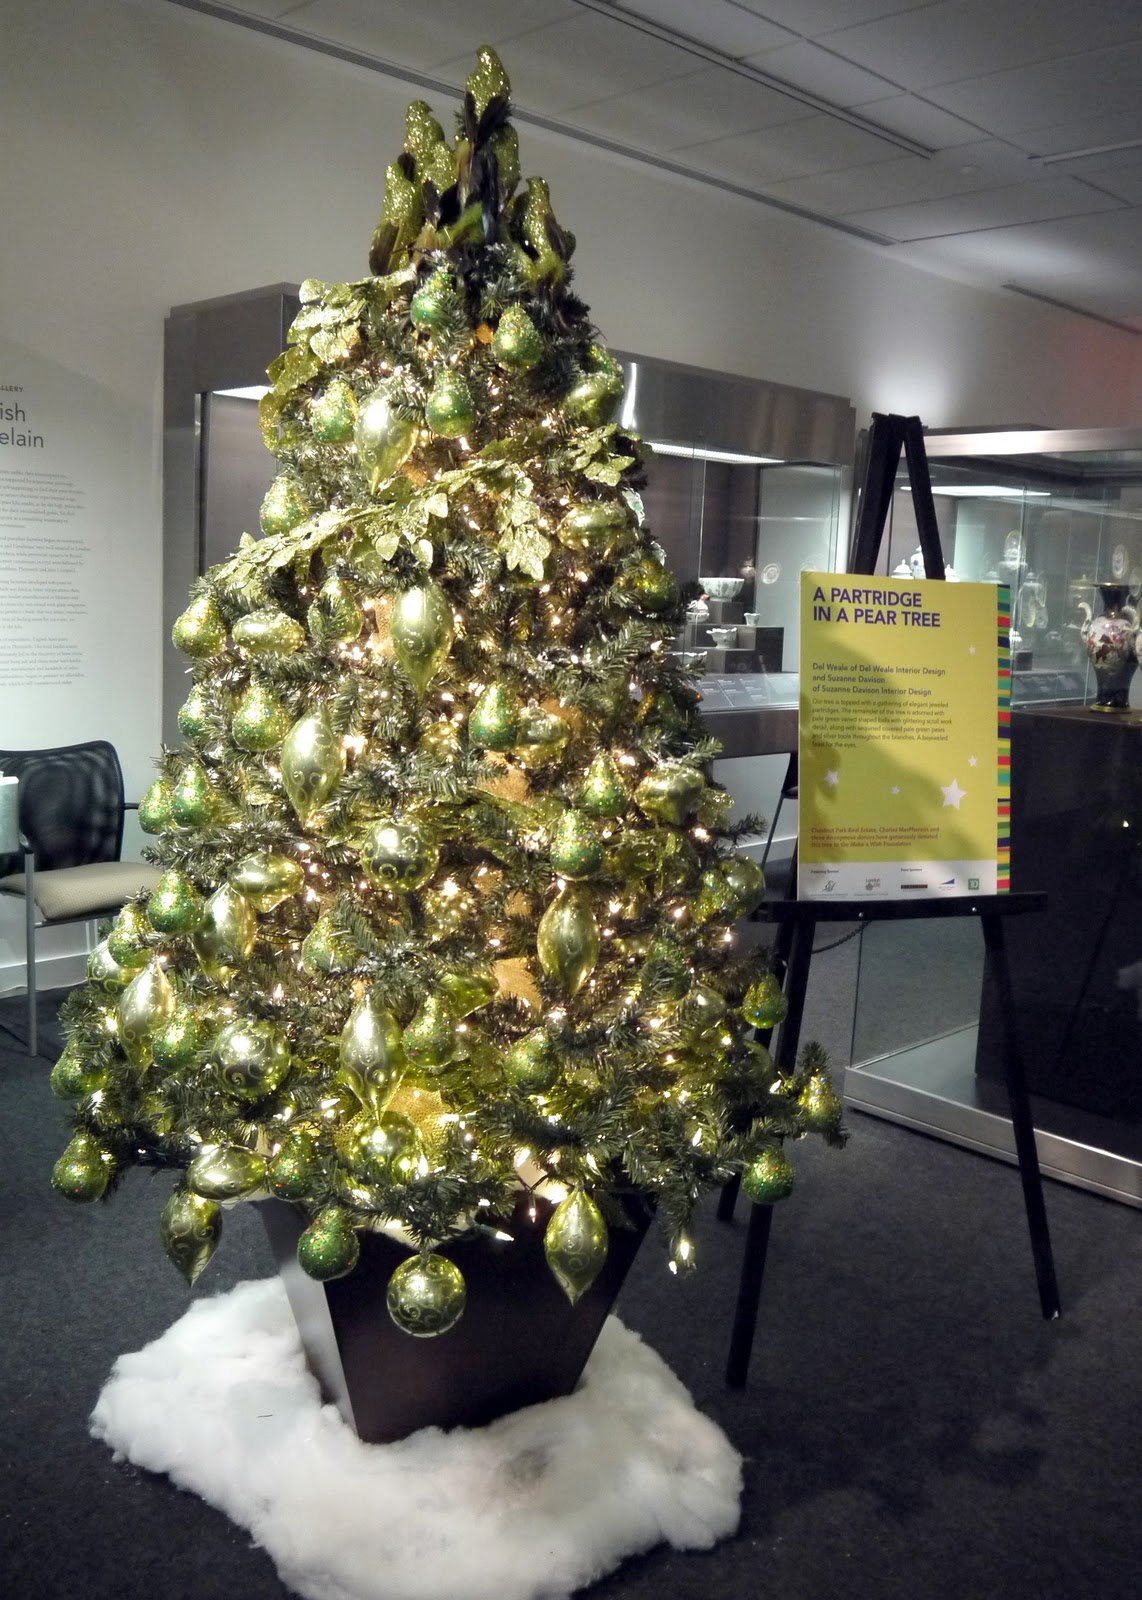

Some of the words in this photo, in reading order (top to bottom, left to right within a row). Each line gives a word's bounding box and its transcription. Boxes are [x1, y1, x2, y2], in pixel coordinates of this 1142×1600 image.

[0, 384, 24, 392] LLERY
[0, 402, 26, 422] ish
[0, 427, 44, 448] elain
[813, 587, 825, 601] A
[831, 587, 922, 607] PARTRIDGE
[813, 606, 831, 621] IN
[836, 607, 849, 622] A
[854, 608, 897, 625] PEAR
[901, 611, 941, 627] TREE
[827, 663, 848, 671] Weale
[850, 664, 857, 672] of
[873, 665, 894, 673] Weale
[896, 666, 921, 674] Interior
[923, 667, 946, 676] Design
[828, 674, 856, 682] Suzanne
[822, 685, 850, 693] Suzanne
[852, 686, 879, 694] Davison
[882, 687, 906, 695] Interior
[909, 688, 932, 697] Design
